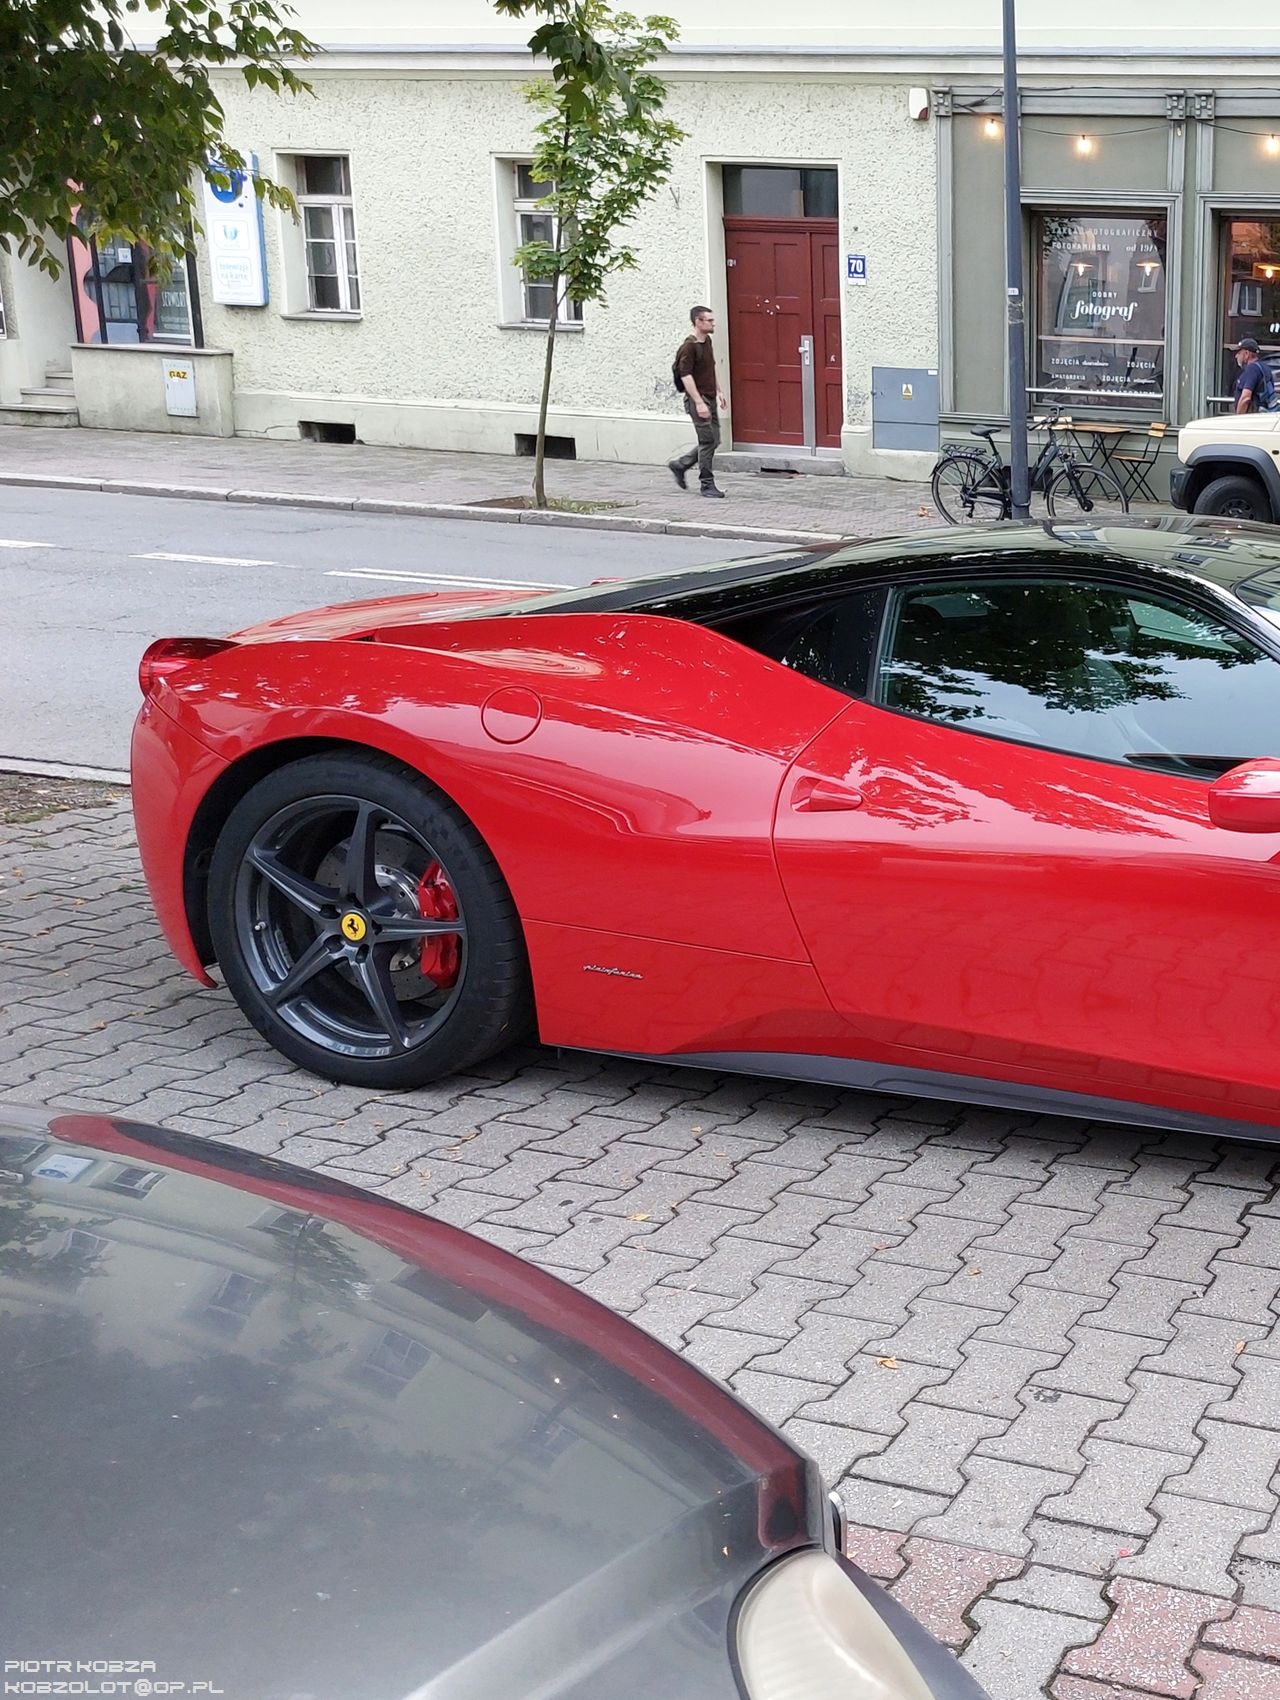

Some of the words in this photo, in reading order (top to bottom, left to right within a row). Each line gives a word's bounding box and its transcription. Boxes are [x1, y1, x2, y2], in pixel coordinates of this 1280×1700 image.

[1126, 243, 1136, 252] od
[849, 259, 863, 273] 70
[1092, 291, 1118, 299] DOBRY
[1070, 300, 1139, 322] fotograf
[1051, 358, 1080, 366] ZDJĘCIA
[1126, 361, 1156, 370] ZDJĘCIA
[1101, 375, 1131, 383] ZDJĘCIA
